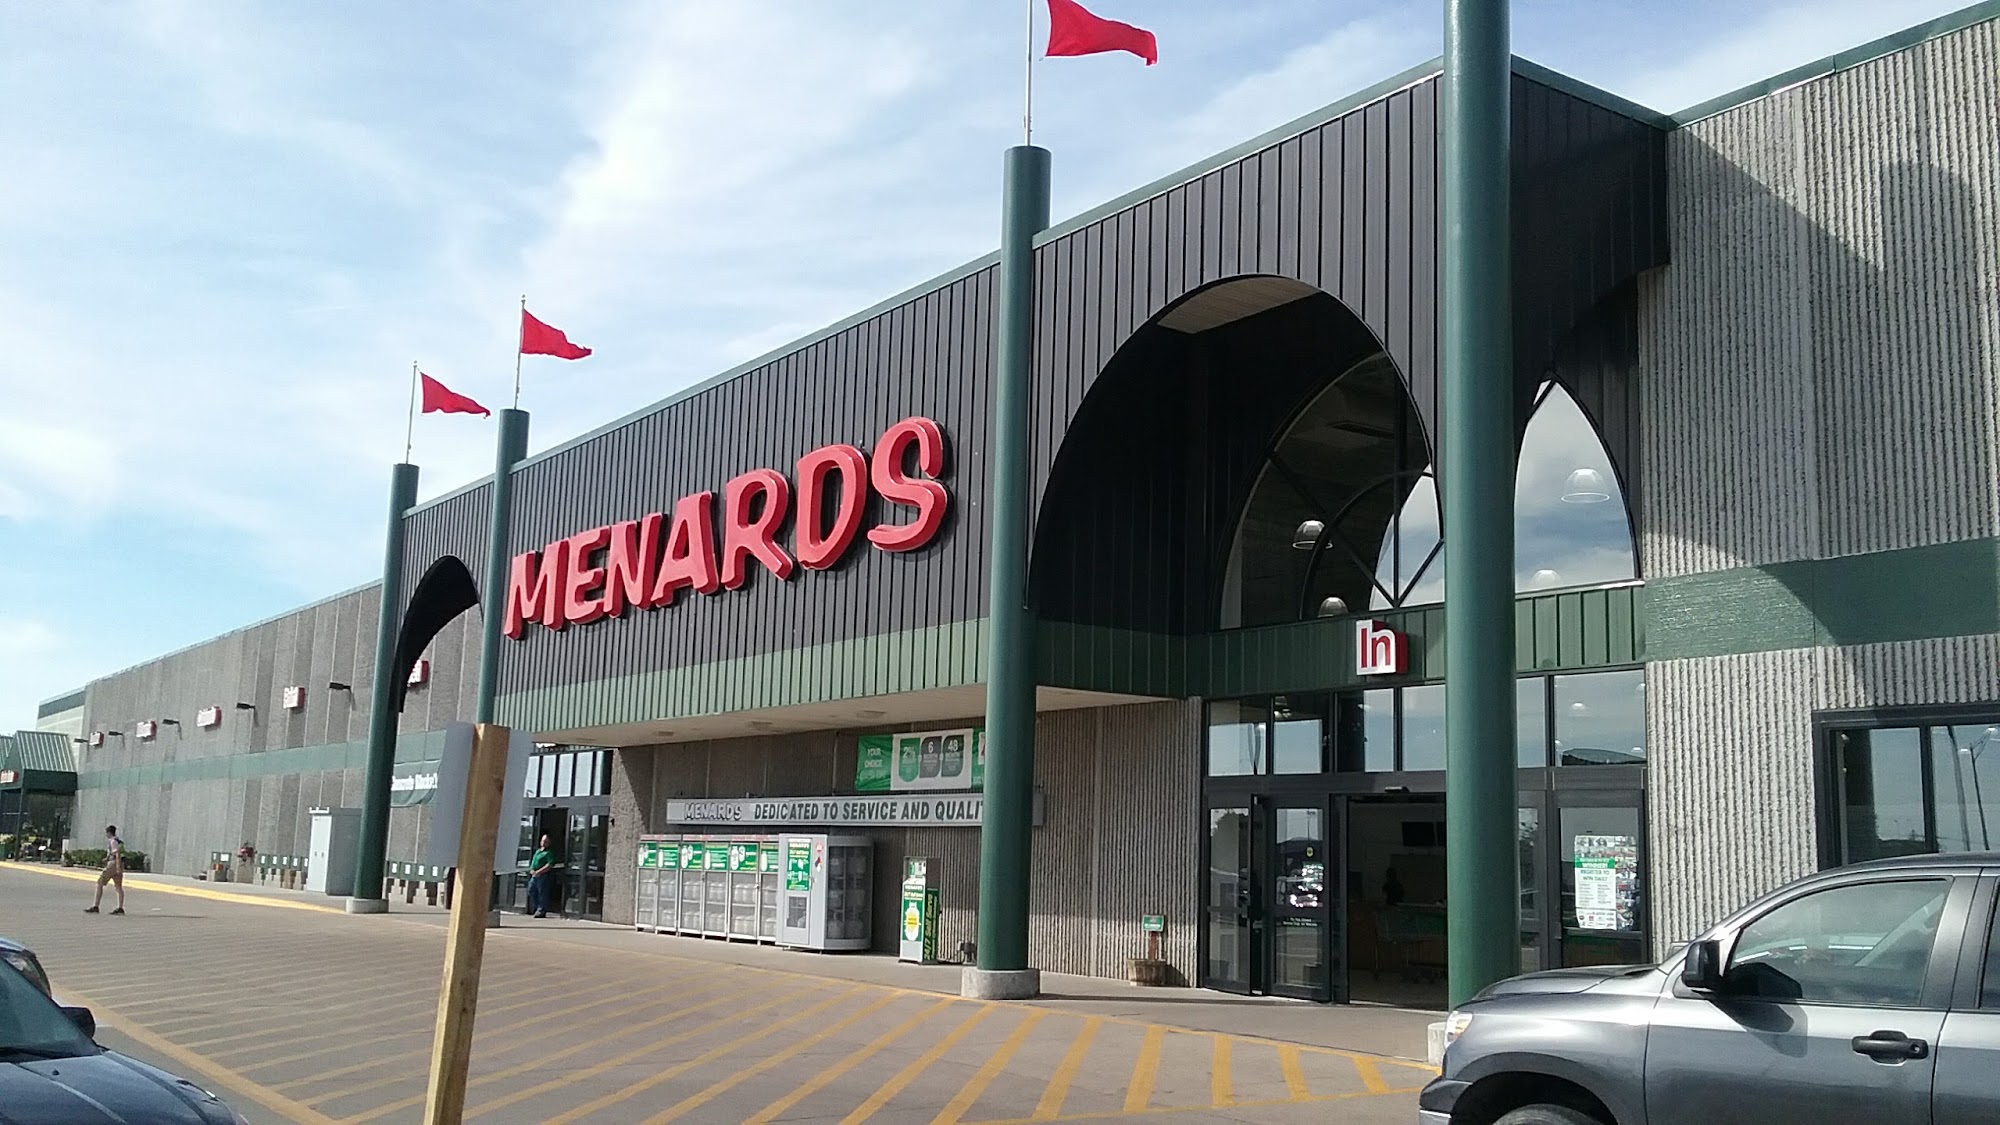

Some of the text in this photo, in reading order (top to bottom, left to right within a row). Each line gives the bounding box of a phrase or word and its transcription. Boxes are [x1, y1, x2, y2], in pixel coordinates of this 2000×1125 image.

[503, 416, 948, 640] MENARDS
[1358, 622, 1394, 672] In
[927, 741, 934, 753] 6
[684, 802, 742, 821] MENARDS
[754, 802, 819, 820] DEDICATED
[823, 802, 838, 820] TO
[842, 802, 898, 820] SERVICE
[900, 801, 930, 820] AND
